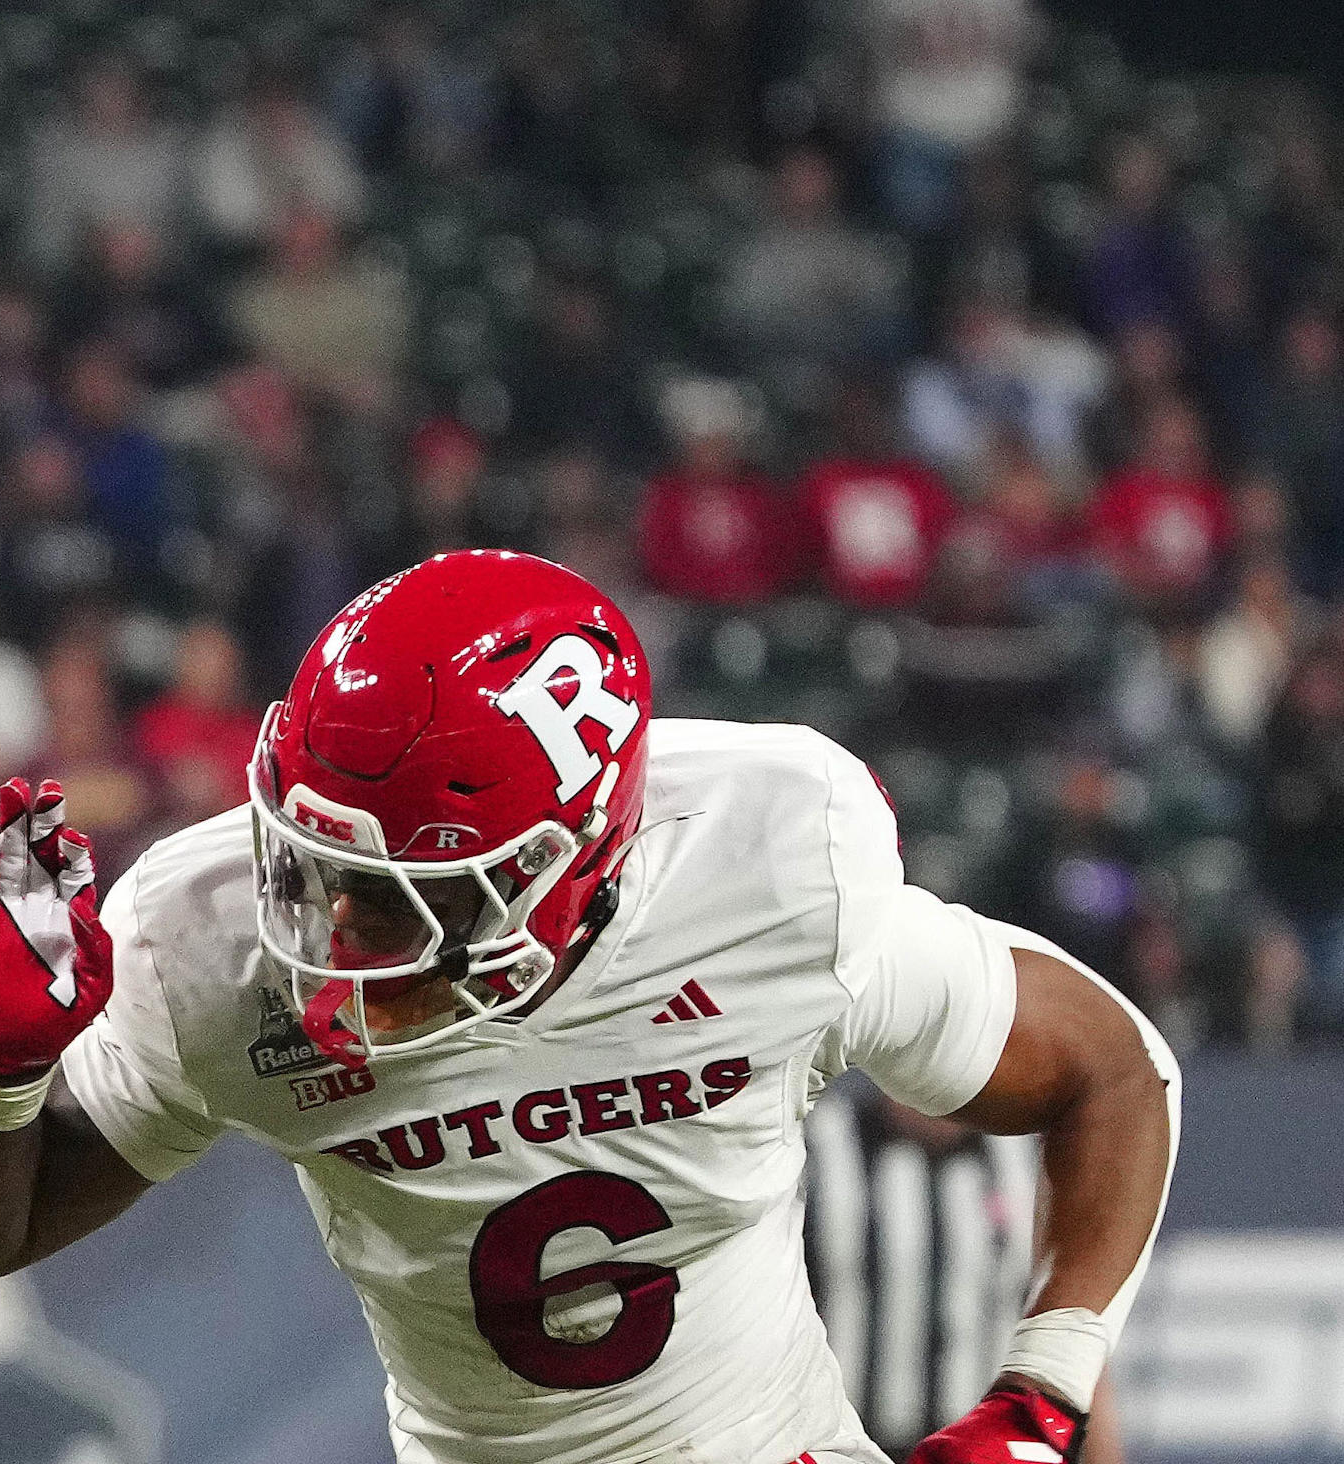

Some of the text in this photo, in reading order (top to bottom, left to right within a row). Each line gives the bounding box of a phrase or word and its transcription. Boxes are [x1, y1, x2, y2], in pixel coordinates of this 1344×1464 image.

[494, 632, 642, 806] R
[436, 829, 460, 849] R
[318, 1056, 753, 1177] RUTGERS
[468, 1169, 681, 1390] 6
